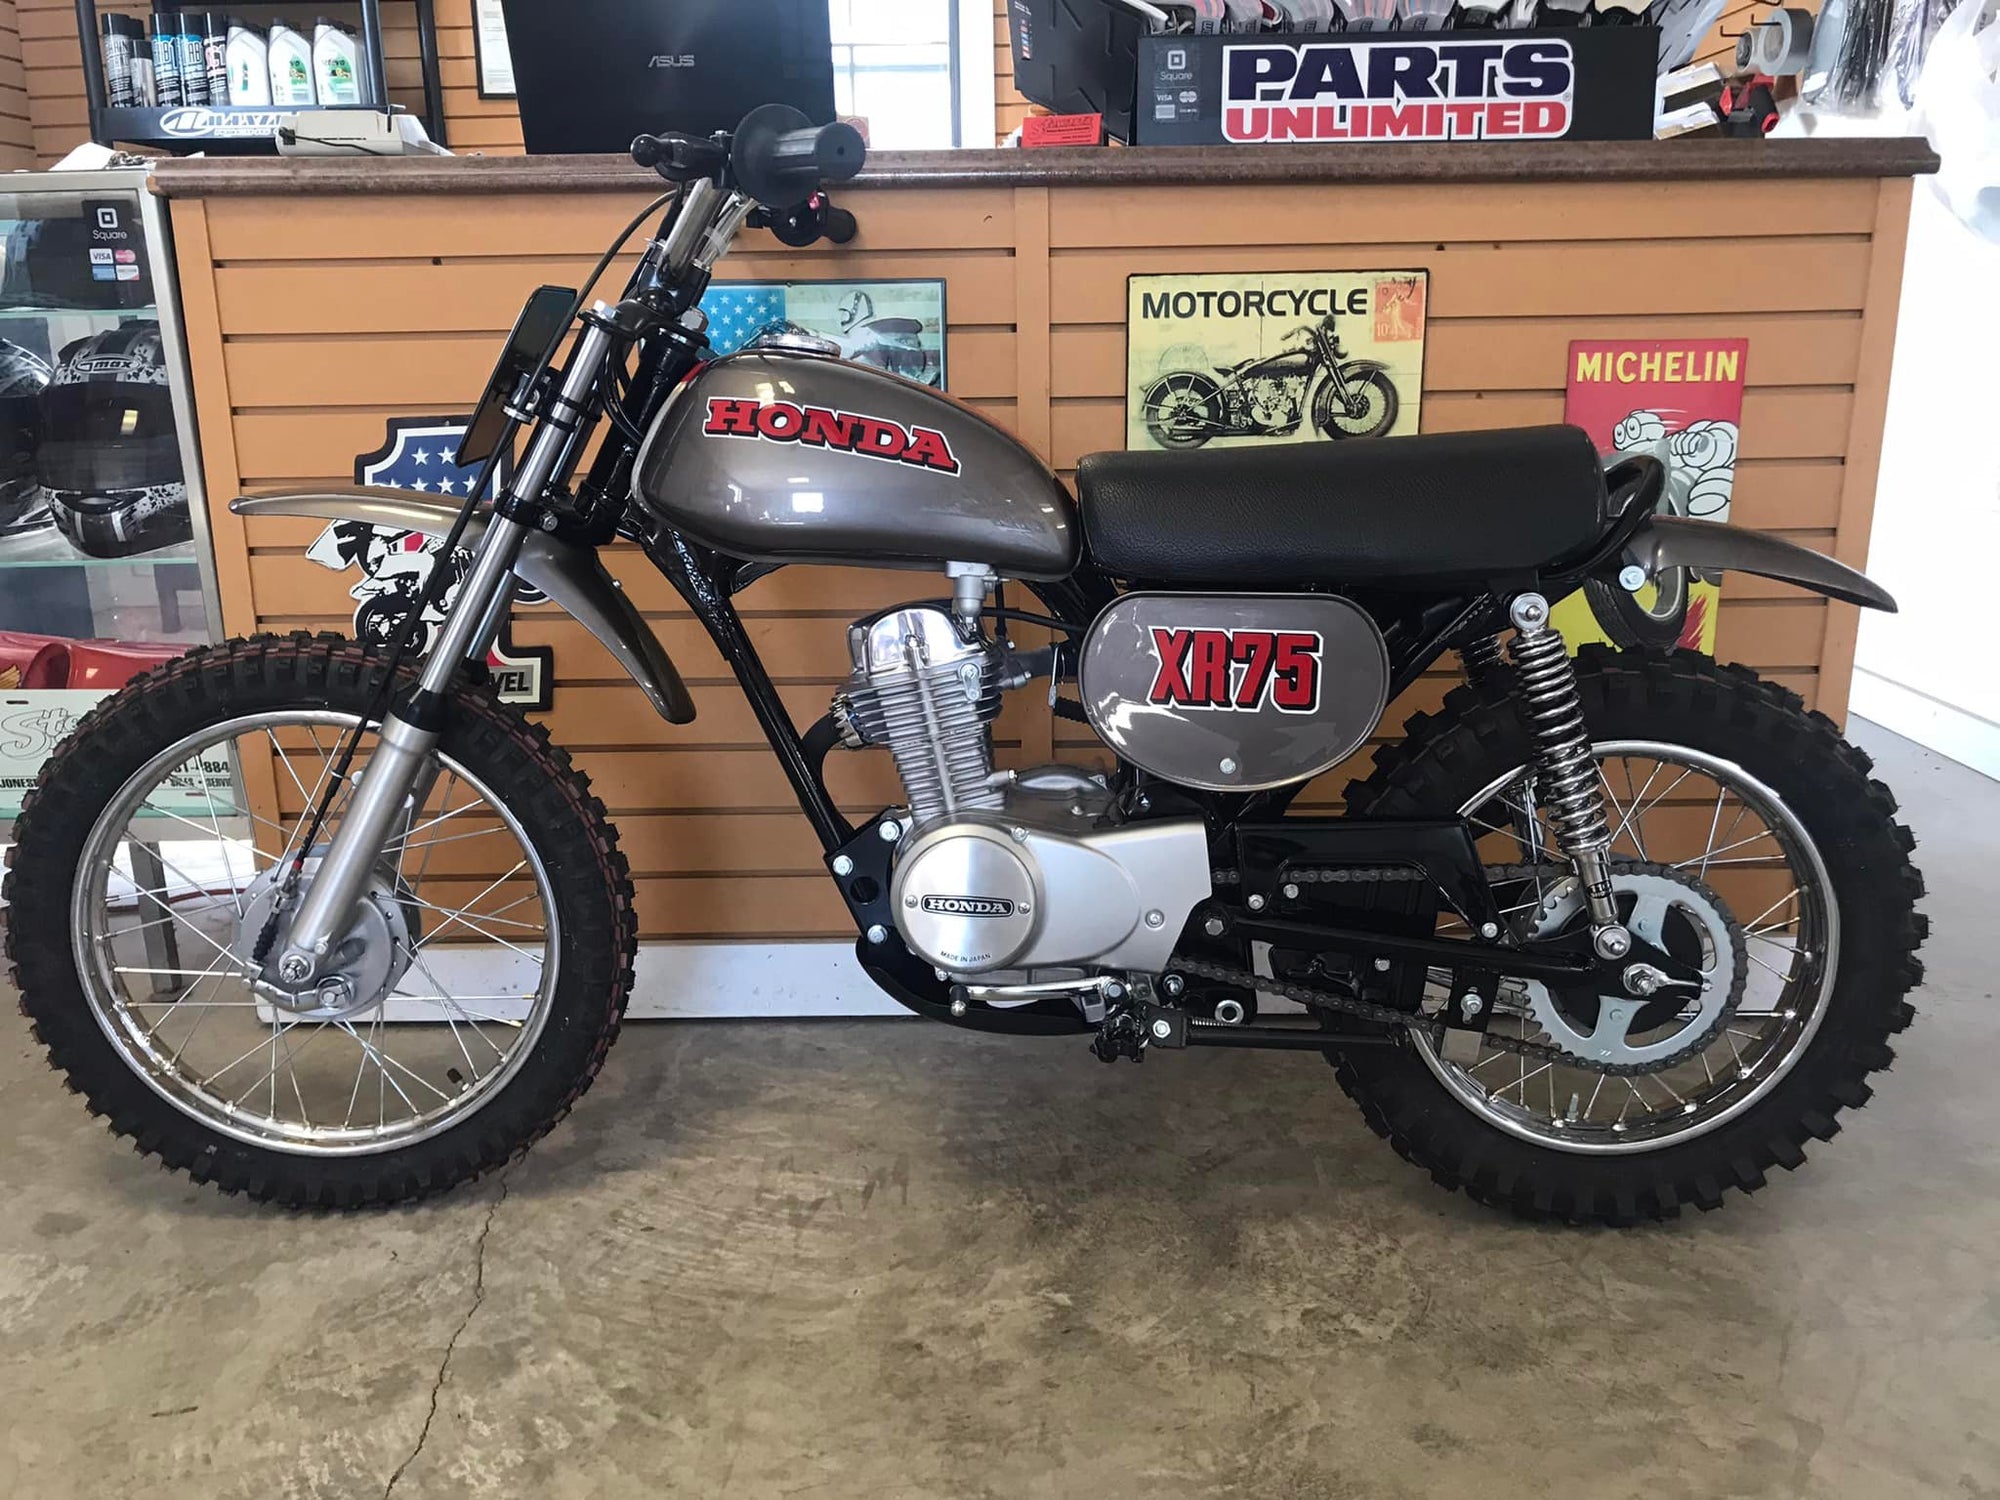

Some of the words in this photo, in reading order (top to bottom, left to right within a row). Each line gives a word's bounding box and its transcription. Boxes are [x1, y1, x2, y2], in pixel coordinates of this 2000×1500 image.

[648, 55, 695, 68] ASUS
[1160, 71, 1193, 81] Square
[1228, 43, 1571, 101] PARTS
[1156, 94, 1173, 102] VISA
[1226, 101, 1567, 140] UNLIMITED
[92, 229, 128, 241] Square
[1142, 288, 1368, 319] MOTORCYCLE
[1575, 350, 1739, 383] MICHELIN
[704, 398, 960, 476] HONDA
[1148, 627, 1321, 713] XR75
[490, 671, 529, 692] VEL
[0, 778, 40, 788] JONEST
[928, 898, 1007, 914] HONDA
[940, 950, 959, 962] MADE
[960, 955, 968, 963] IN
[969, 952, 991, 963] JAPAN
